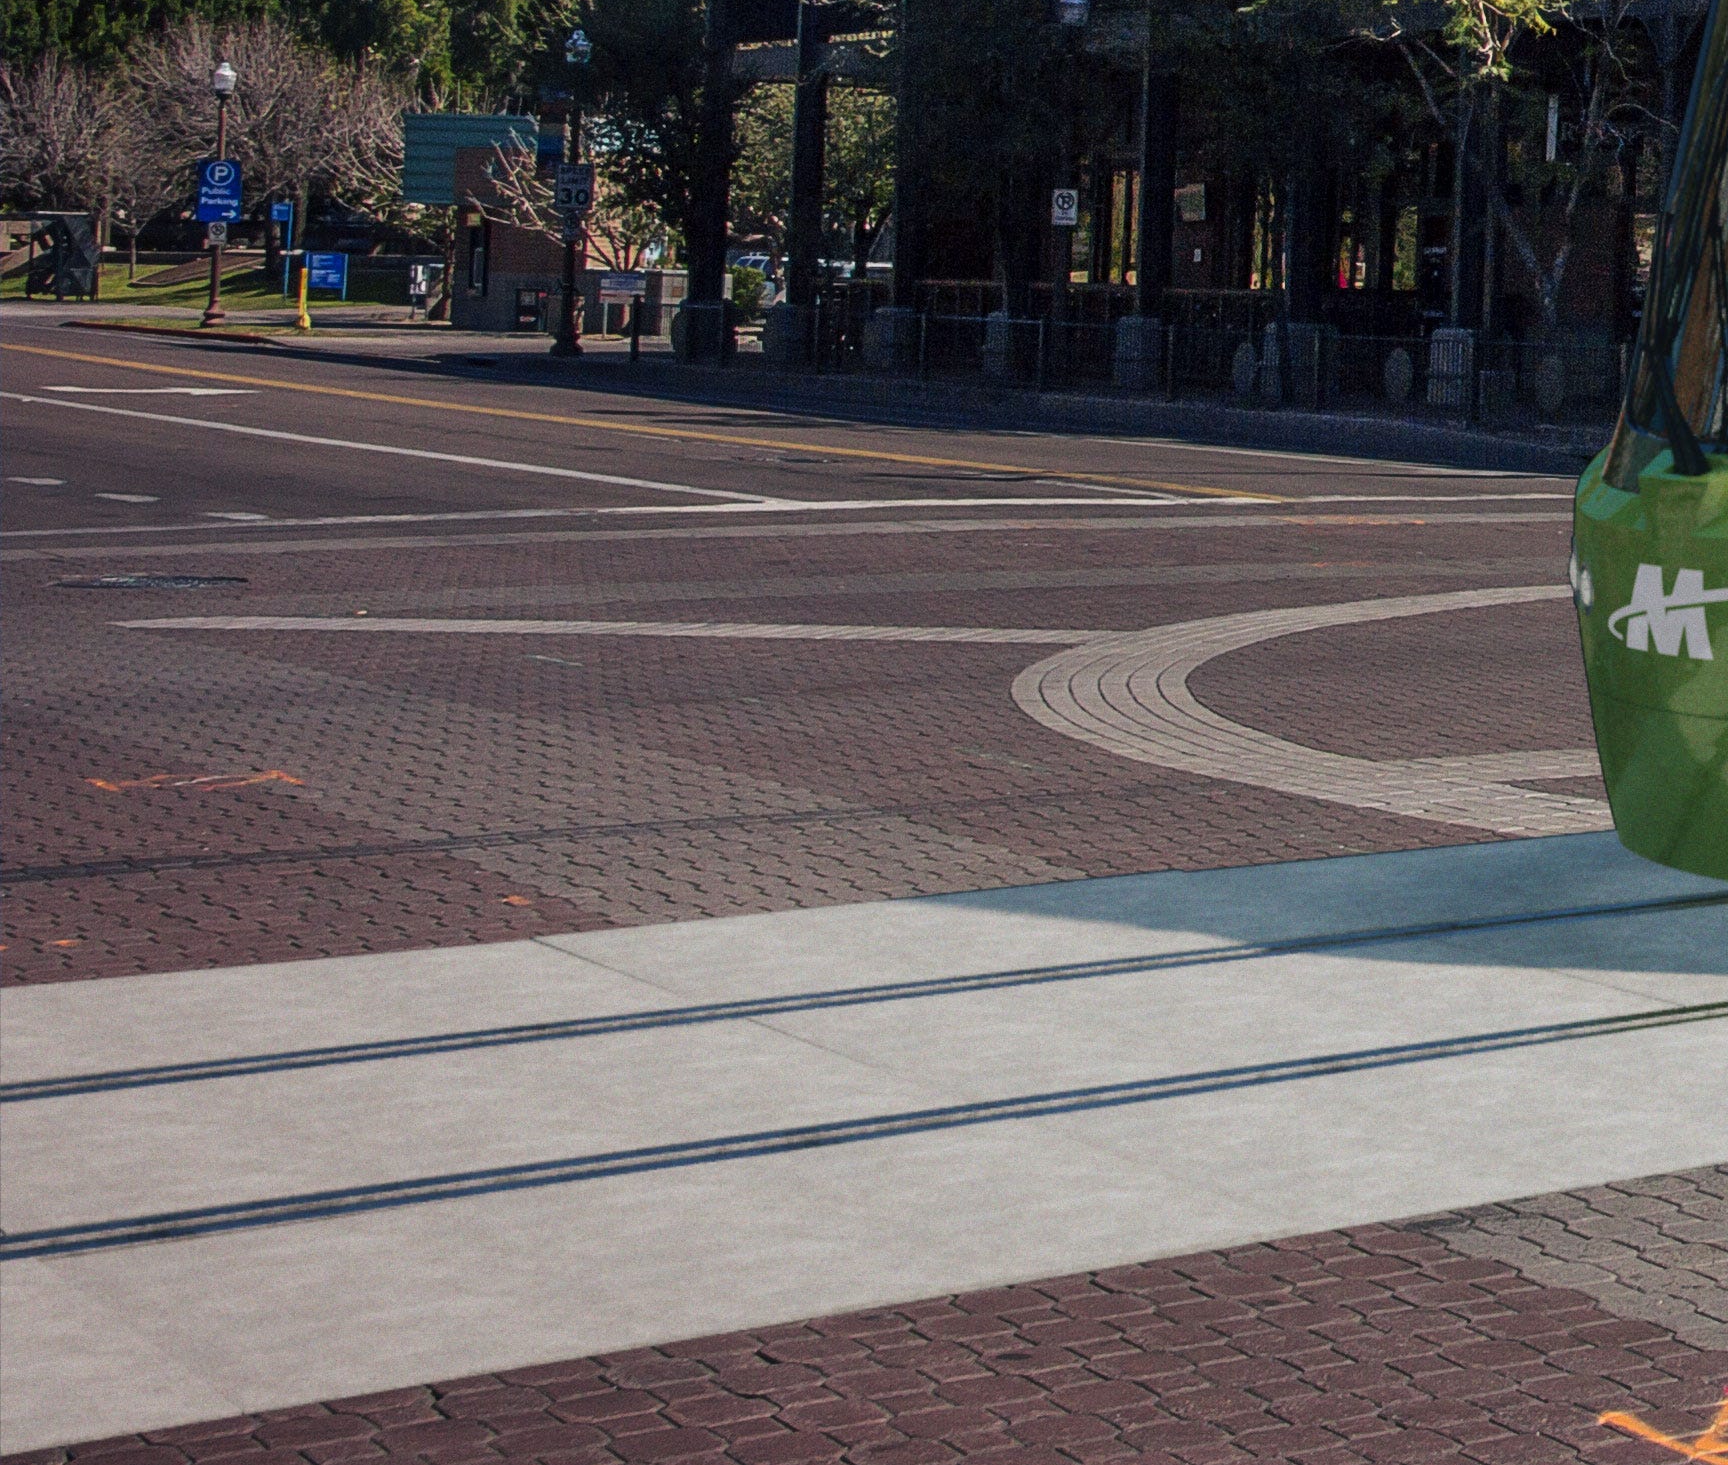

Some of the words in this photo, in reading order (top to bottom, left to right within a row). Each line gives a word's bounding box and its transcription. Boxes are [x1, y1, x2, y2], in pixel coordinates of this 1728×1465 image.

[201, 186, 231, 195] Public
[201, 196, 238, 207] Parking
[560, 188, 589, 205] 30
